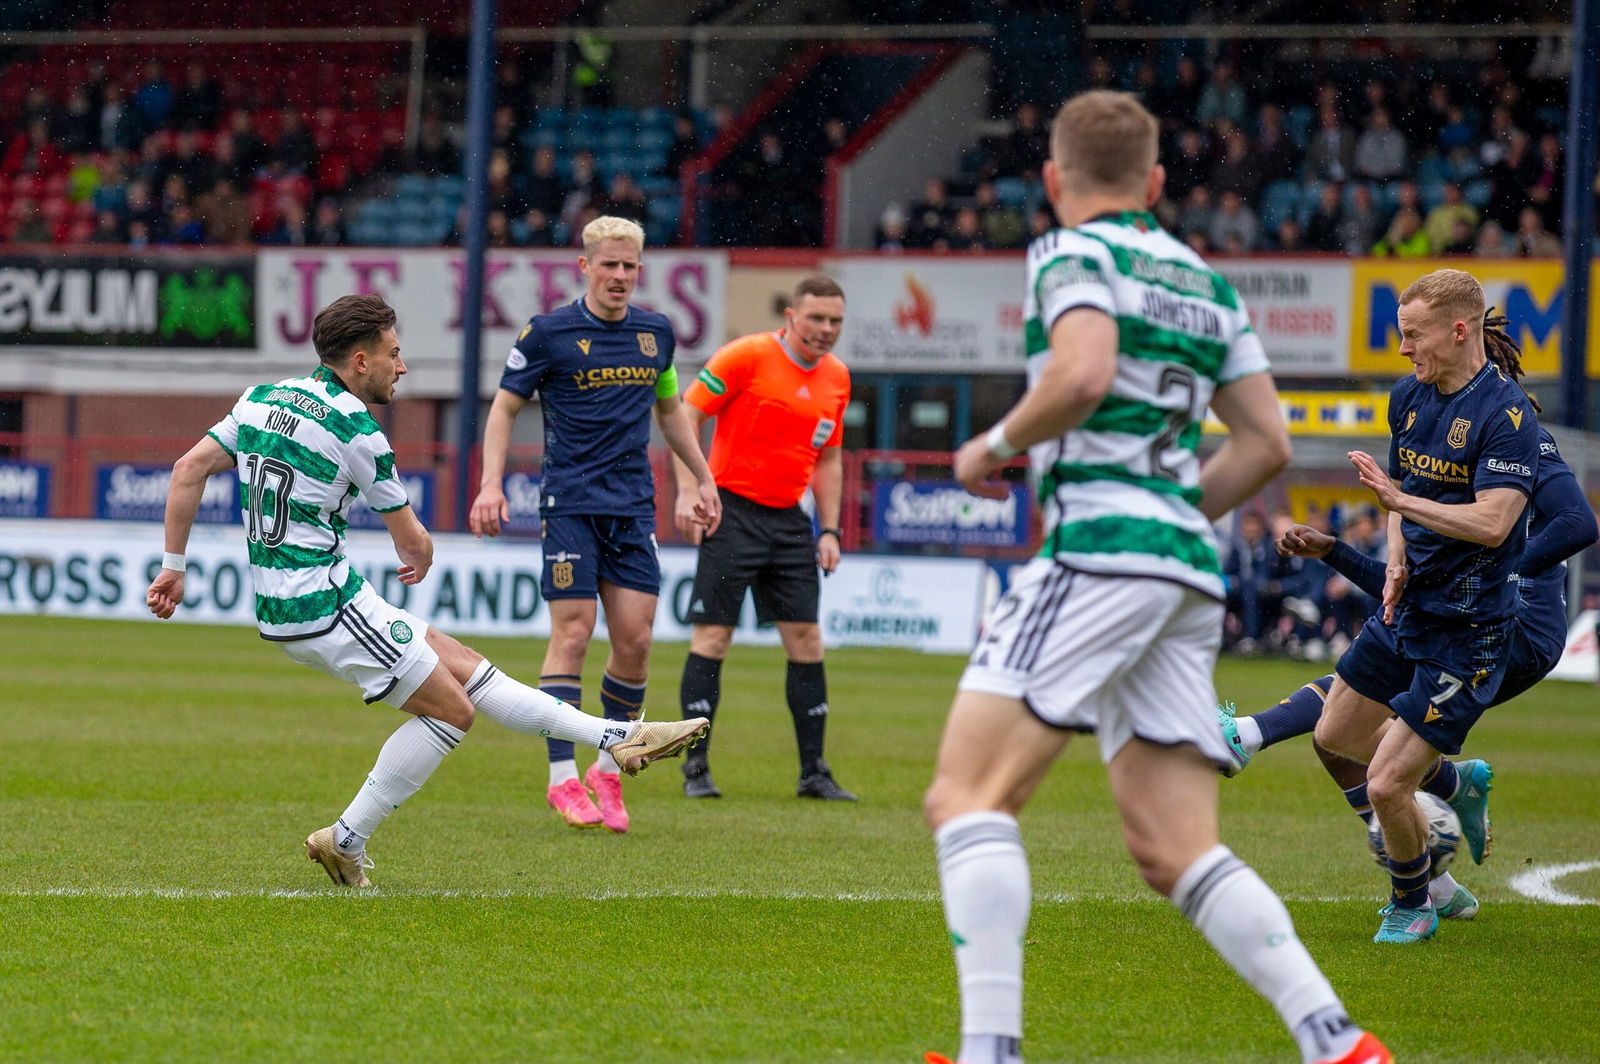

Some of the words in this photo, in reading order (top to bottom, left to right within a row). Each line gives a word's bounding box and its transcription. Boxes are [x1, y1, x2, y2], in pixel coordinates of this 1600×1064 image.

[1142, 290, 1220, 337] JOHNSTON
[587, 367, 659, 381] CROWN
[266, 389, 331, 419] MAGNERS
[264, 408, 301, 438] KÜHN
[1149, 363, 1198, 484] 2
[1398, 447, 1469, 476] CROWN
[1419, 470, 1443, 481] services
[246, 453, 296, 548] 10
[431, 566, 540, 621] AND
[828, 612, 940, 637] CAMERON
[1430, 671, 1464, 705] 7
